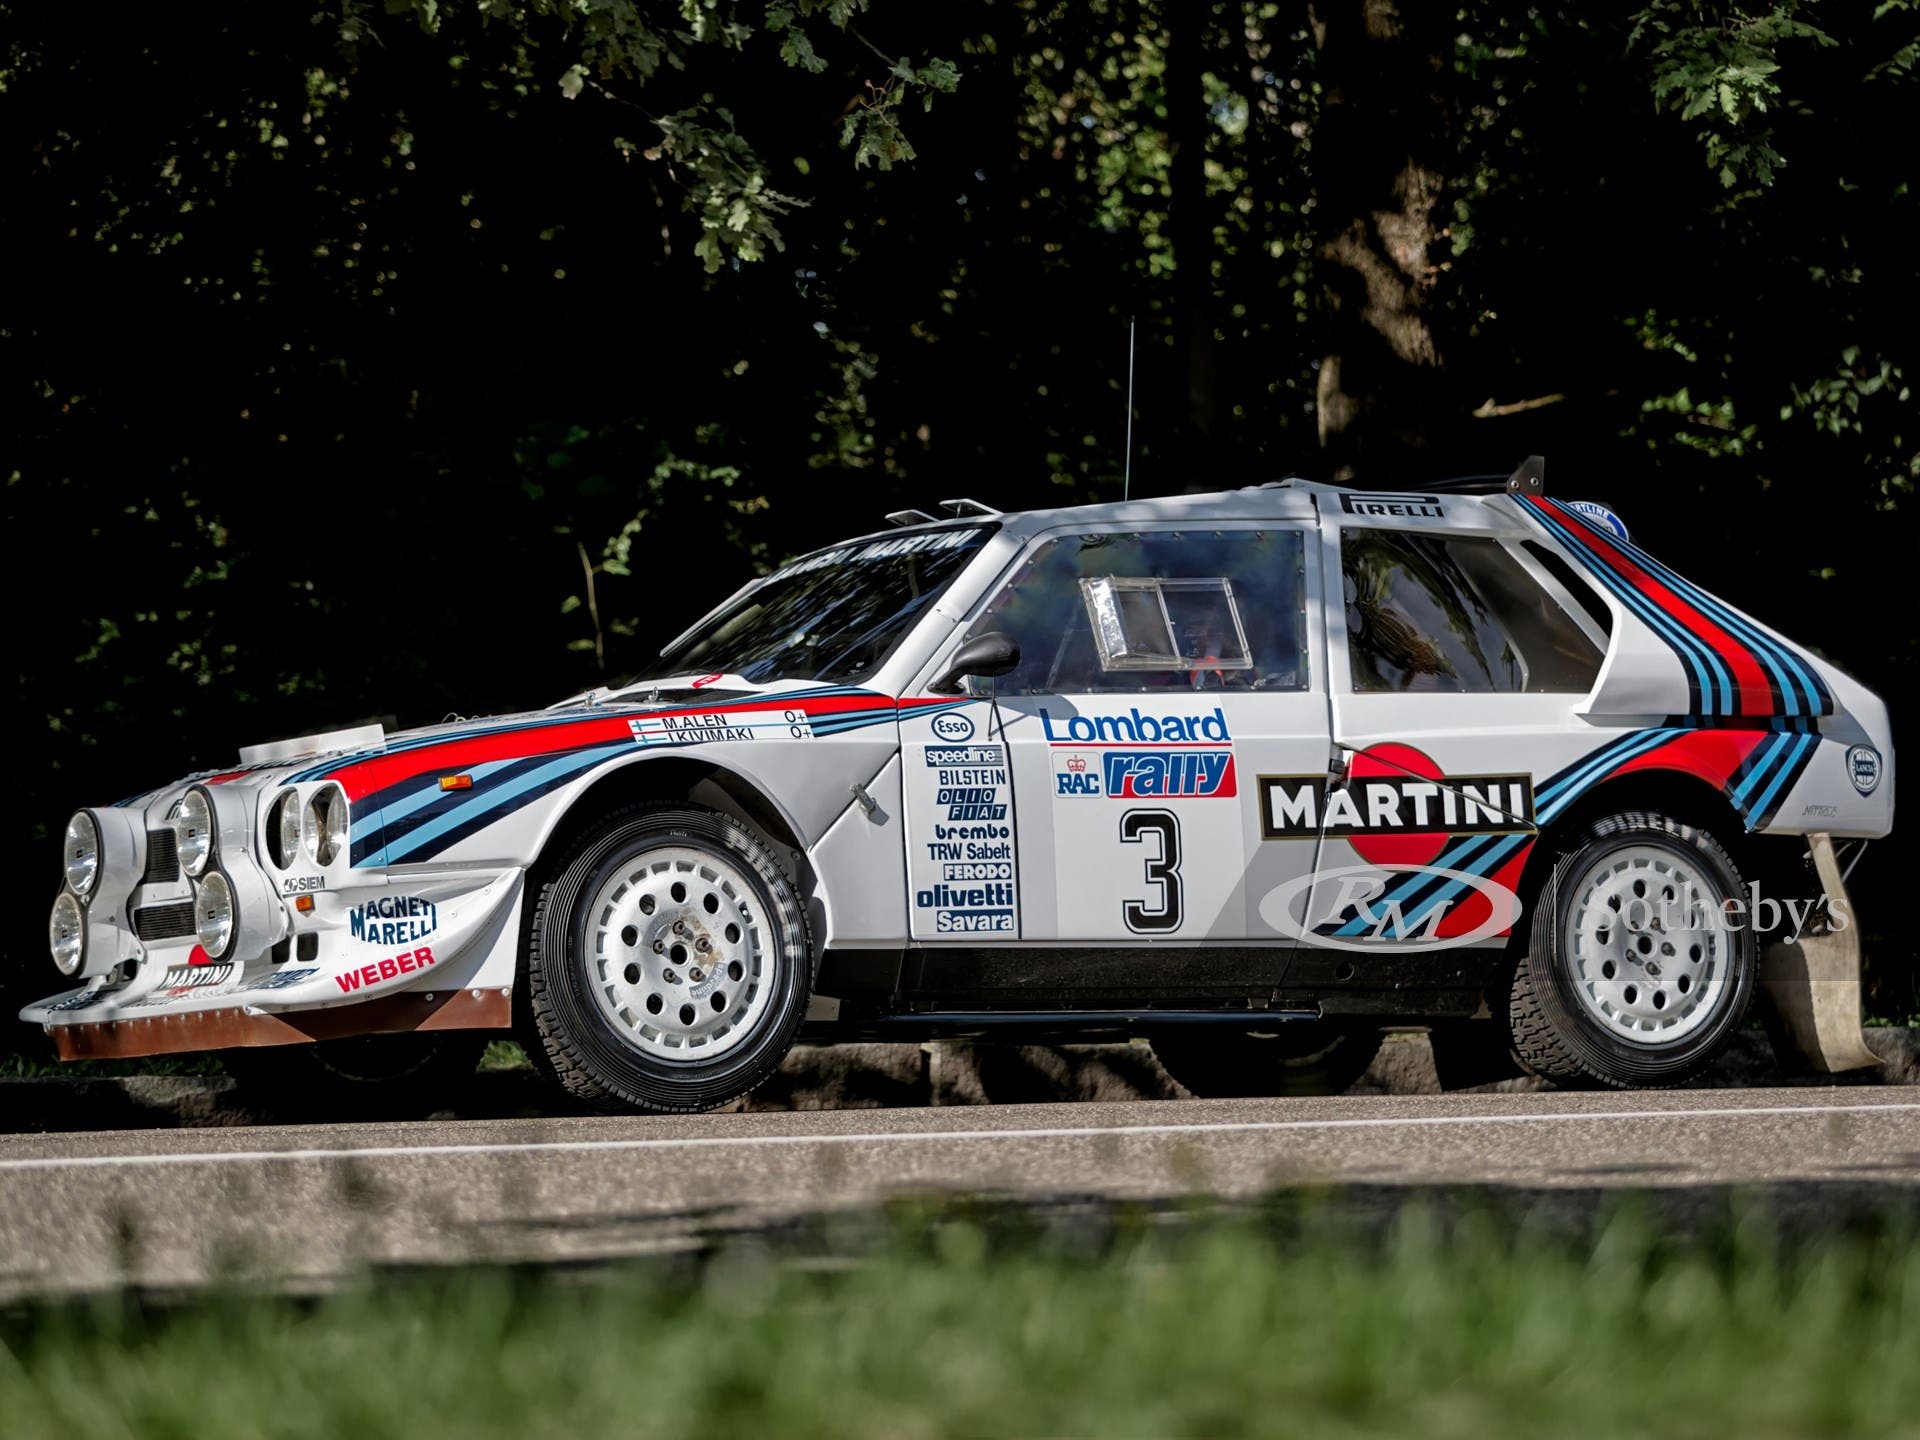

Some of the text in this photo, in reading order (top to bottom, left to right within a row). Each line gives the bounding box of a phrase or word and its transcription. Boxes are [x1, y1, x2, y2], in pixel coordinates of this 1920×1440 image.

[1339, 493, 1444, 518] PIRELLI
[849, 528, 983, 563] MARTINI
[937, 719, 969, 733] Esso
[1039, 708, 1231, 742] Lombard
[926, 747, 996, 765] speedline
[939, 769, 1006, 785] BILSTEIN
[1056, 753, 1233, 797] RAC rally
[939, 789, 994, 804] OLIO
[1270, 783, 1522, 828] MARTINI
[950, 805, 1005, 820] FIAT
[935, 824, 1010, 840] brembo
[927, 842, 1011, 861] TRW Sabelt
[944, 864, 1011, 880] FERODO
[1119, 807, 1184, 935] 3
[298, 876, 325, 891] SIEM
[917, 883, 1013, 908] olivetti
[350, 896, 437, 924] MAGNETI
[936, 911, 1014, 932] Savara
[350, 917, 437, 945] MARELLI
[162, 965, 233, 989] MARTINI
[335, 946, 435, 993] WEBER
